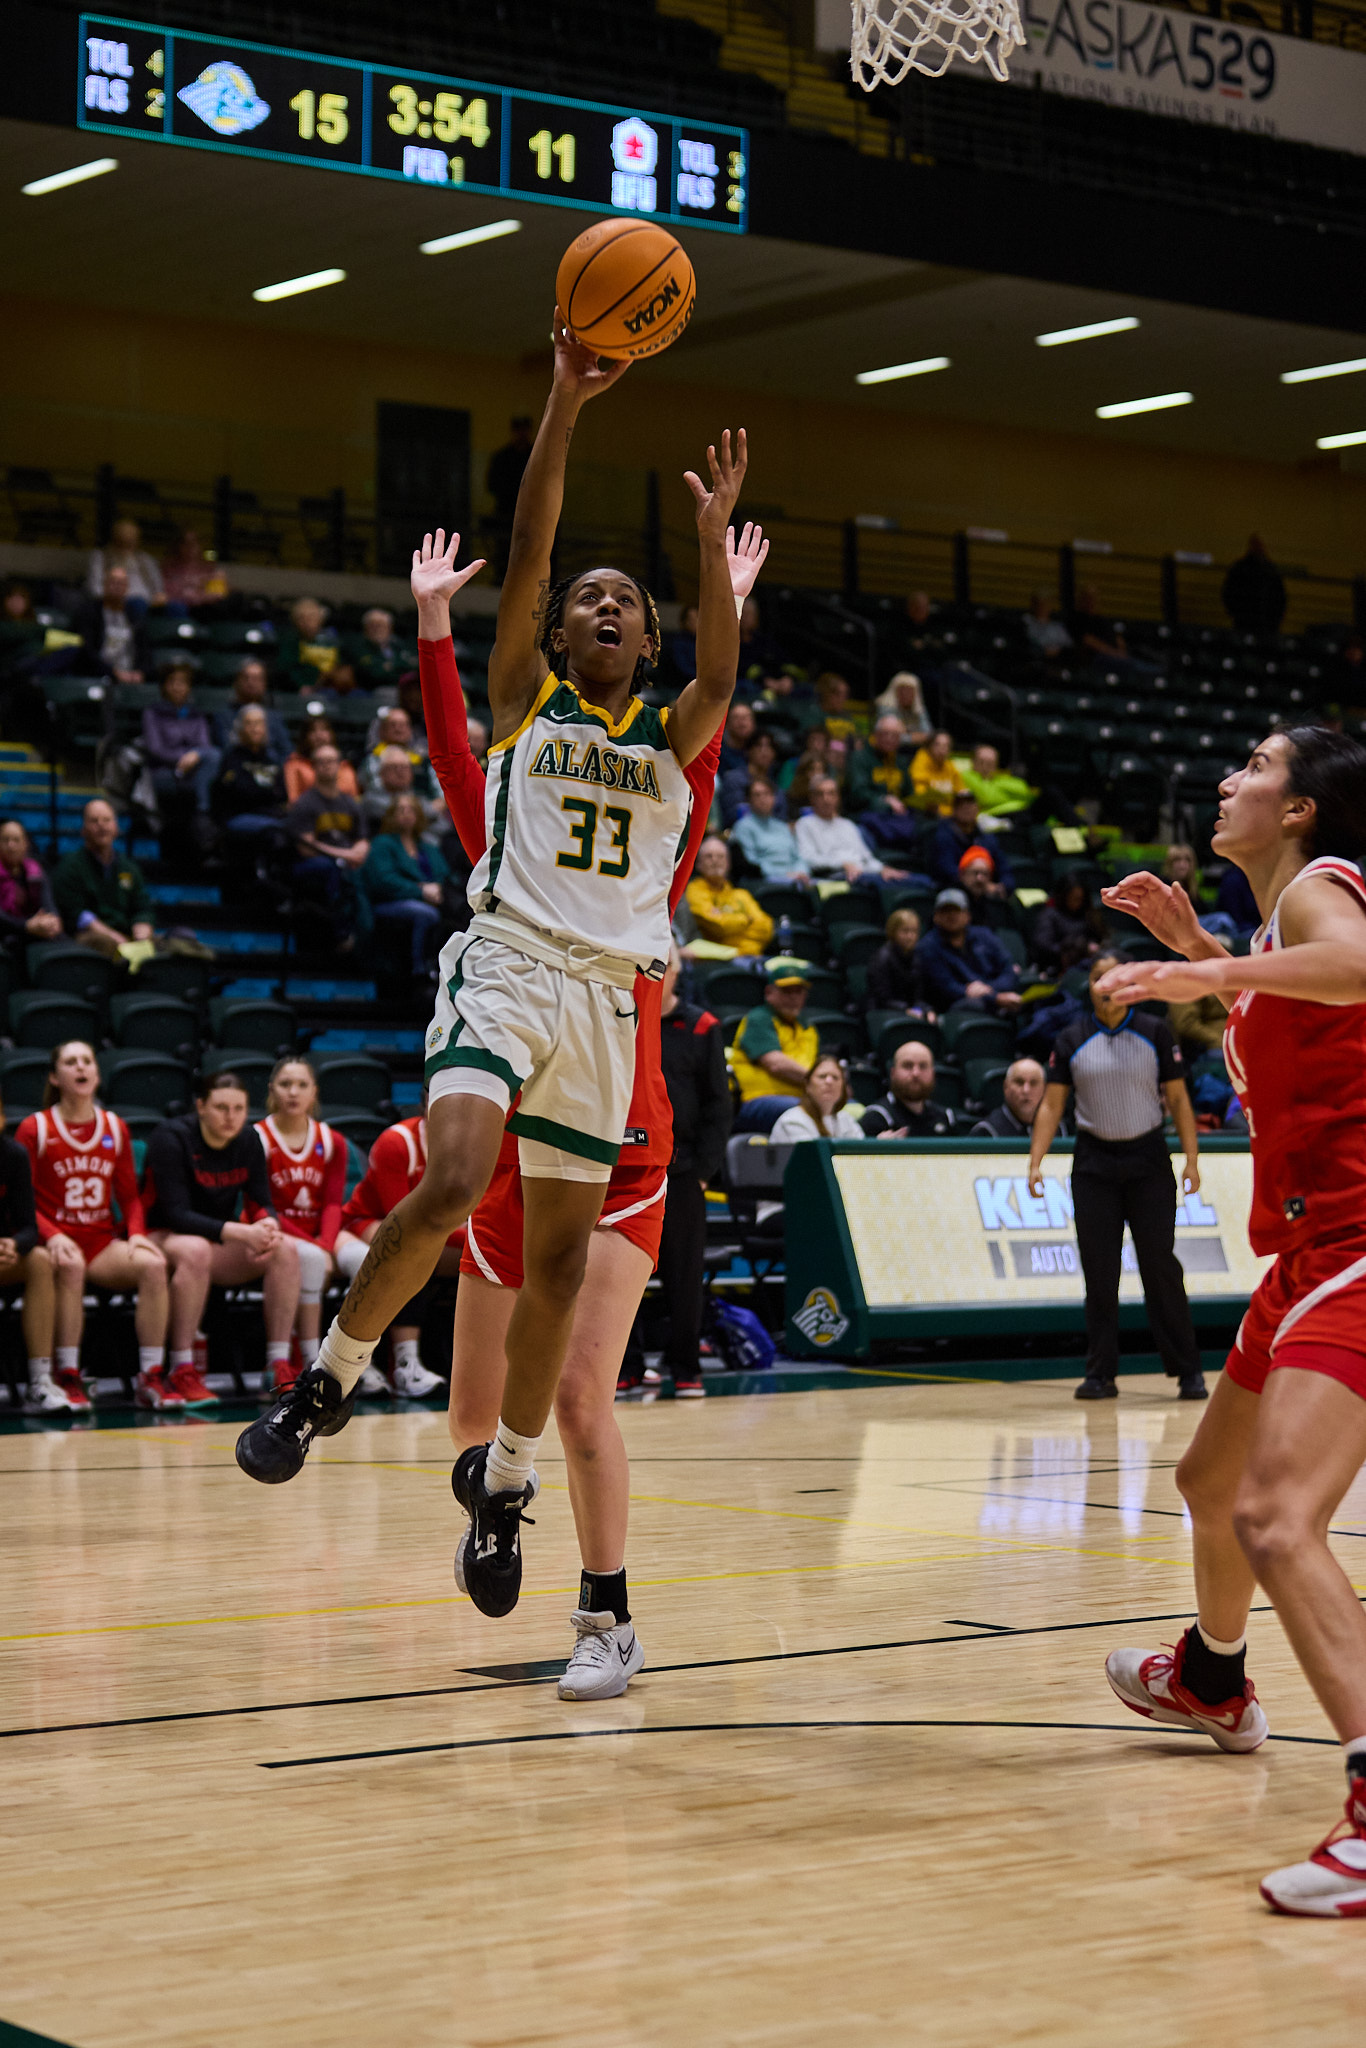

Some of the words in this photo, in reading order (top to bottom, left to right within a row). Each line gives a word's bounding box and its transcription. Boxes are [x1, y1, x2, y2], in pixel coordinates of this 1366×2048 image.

[145, 49, 165, 78] 4
[144, 88, 166, 118] 2
[289, 89, 349, 145] 15
[387, 84, 491, 148] 3:54
[528, 129, 576, 183] 11
[449, 156, 465, 188] 1
[725, 183, 746, 213] 2
[624, 276, 681, 335] NCAA
[528, 738, 662, 803] ALASKA
[555, 795, 633, 880] 33
[637, 1132, 645, 1141] M
[53, 1155, 114, 1178] SIMON
[271, 1166, 322, 1188] SIMON
[65, 1176, 104, 1209] 23
[293, 1185, 312, 1208] 4
[1030, 1245, 1077, 1274] AUTO
